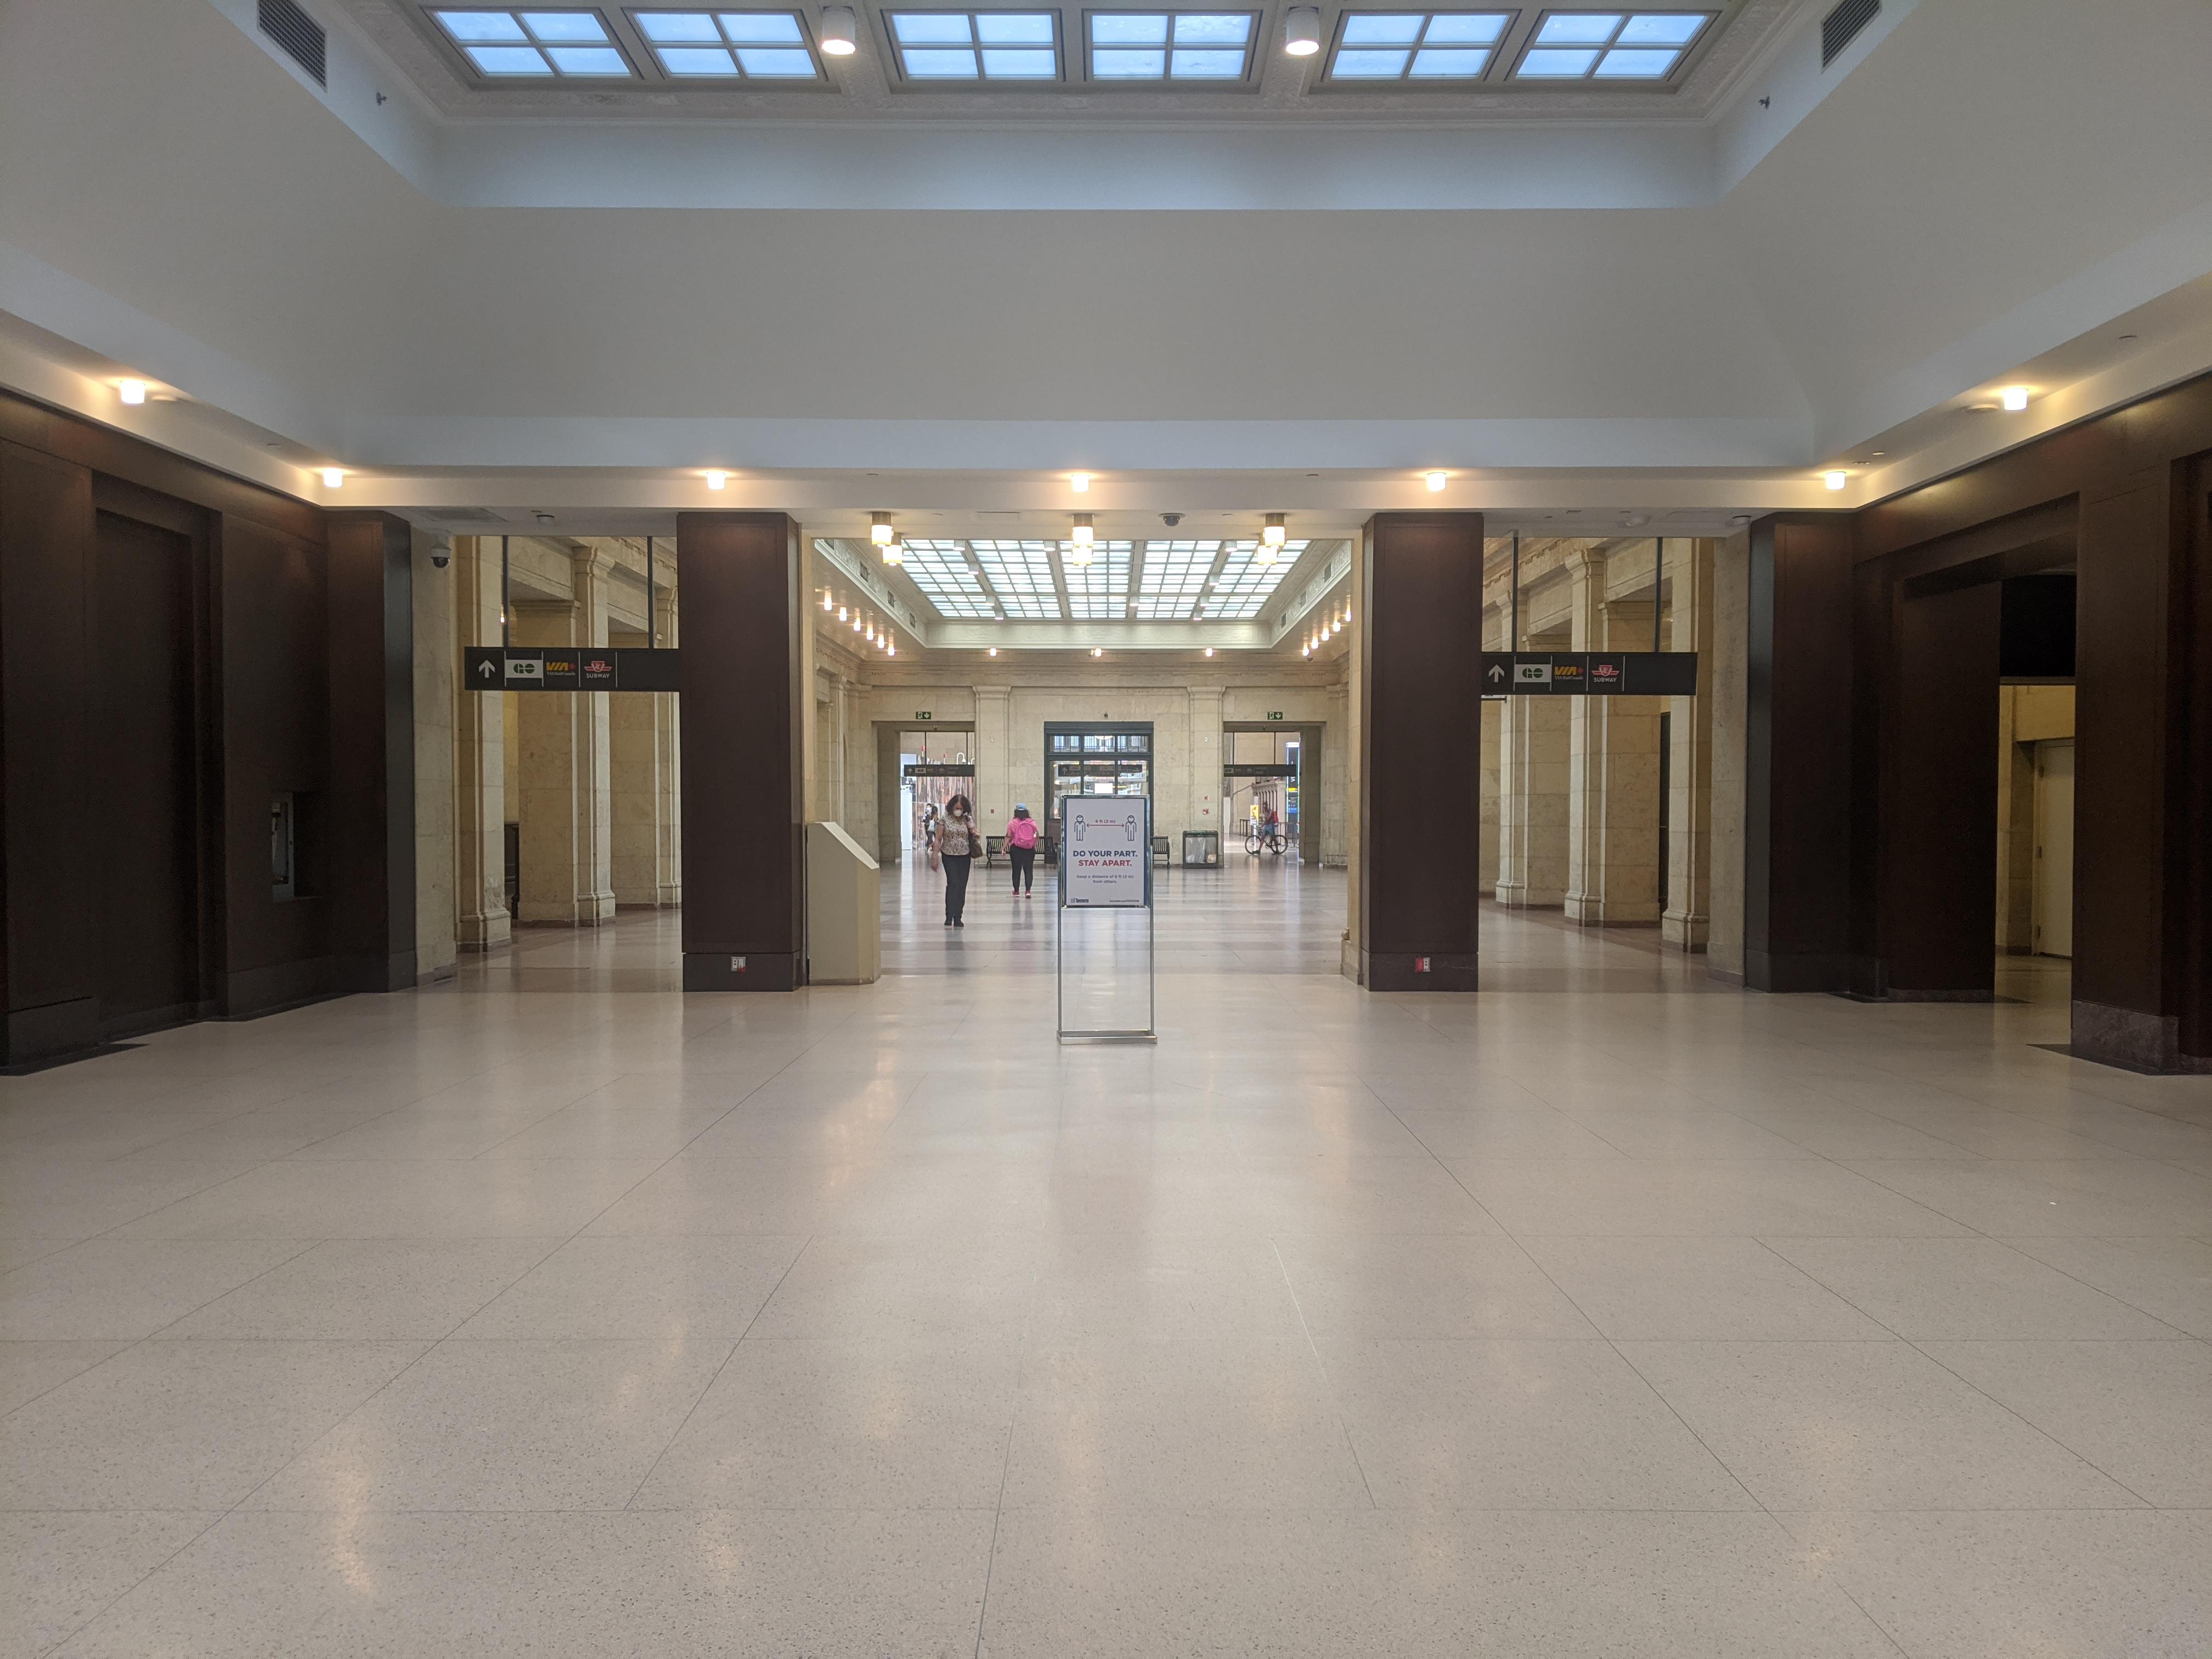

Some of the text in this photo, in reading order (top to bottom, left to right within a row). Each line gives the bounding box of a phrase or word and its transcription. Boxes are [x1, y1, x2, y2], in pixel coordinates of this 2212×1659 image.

[514, 663, 535, 674] GO
[546, 662, 568, 670] VIA
[1522, 668, 1543, 678] GO
[1555, 667, 1577, 675] VIA
